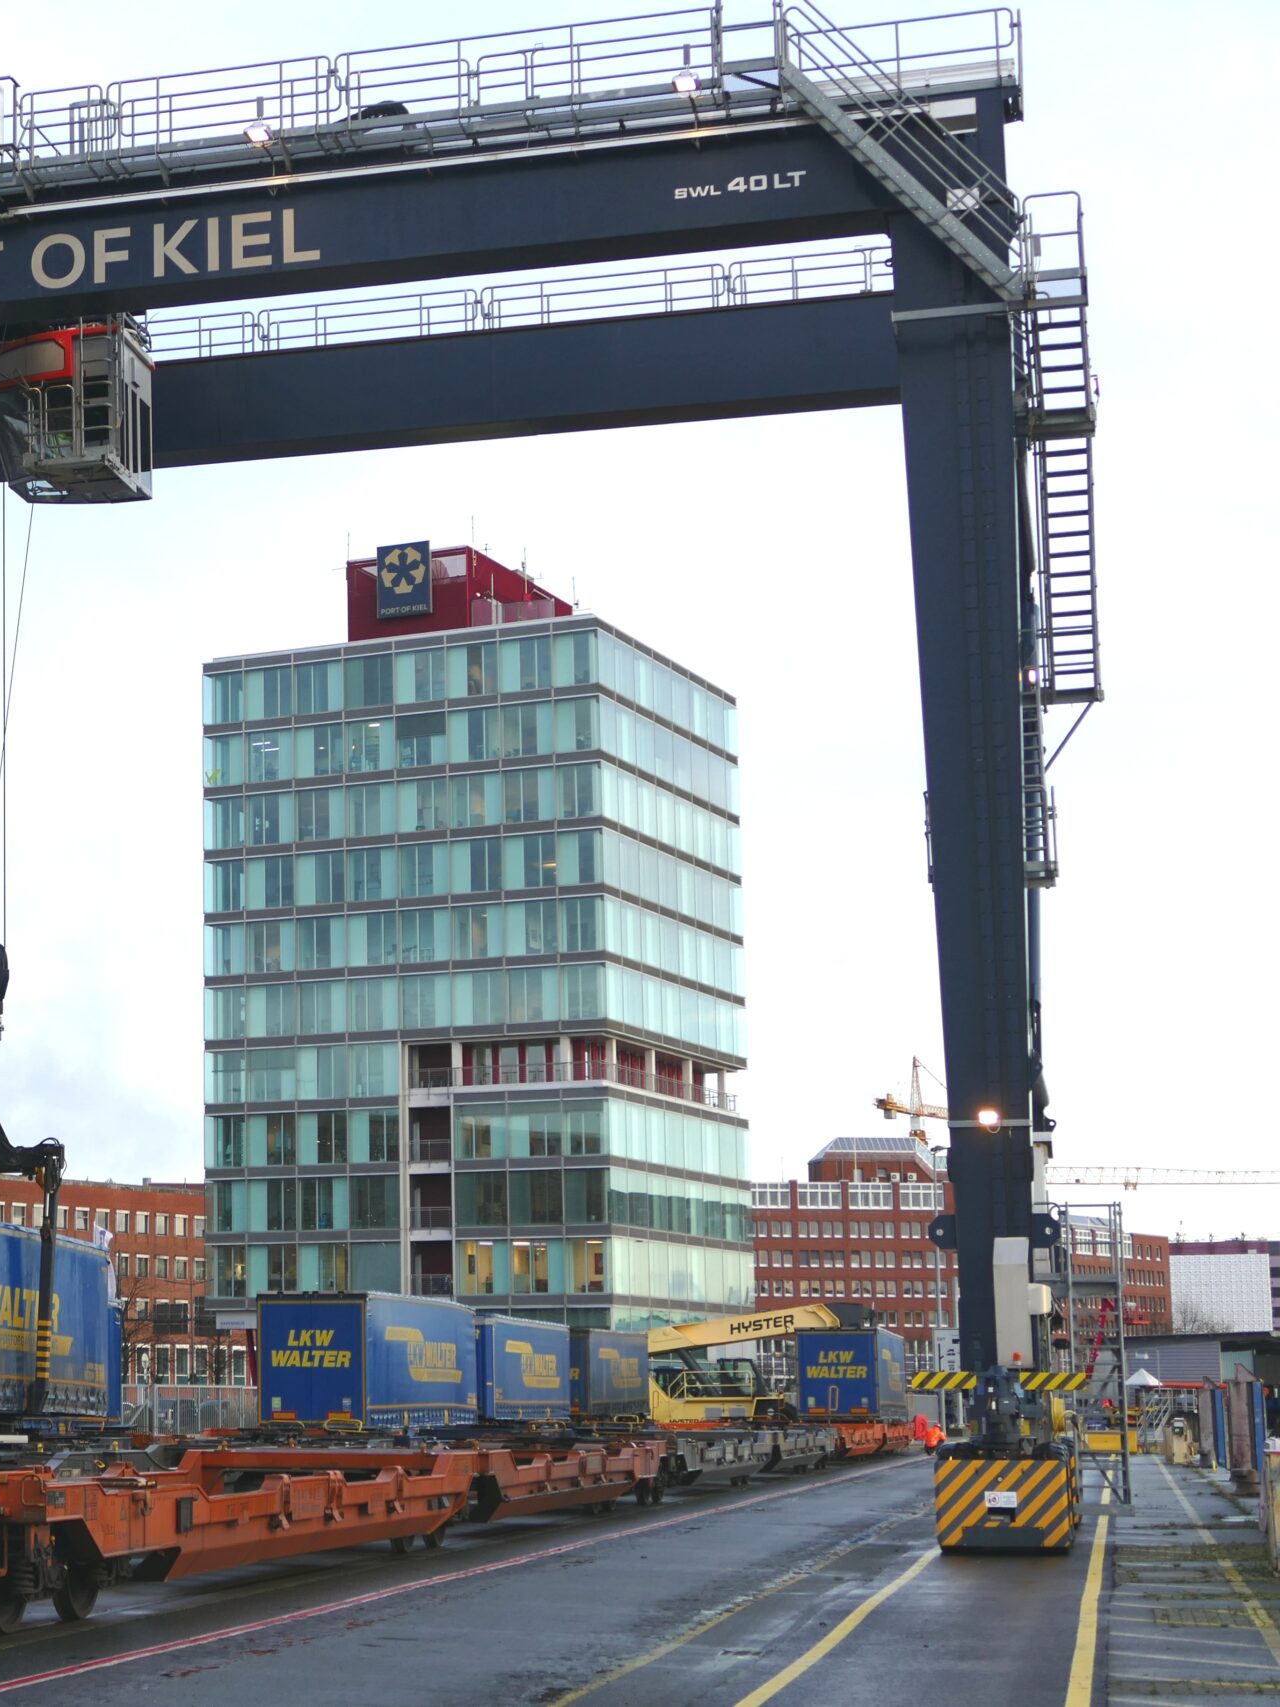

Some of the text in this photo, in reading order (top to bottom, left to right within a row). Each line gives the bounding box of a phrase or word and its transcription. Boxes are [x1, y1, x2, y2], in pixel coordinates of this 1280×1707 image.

[674, 170, 807, 199] SWL 40 LT
[30, 227, 131, 289] OF
[153, 208, 320, 278] KIEL
[381, 607, 400, 615] PORT
[401, 605, 412, 613] OF
[730, 1314, 794, 1335] HYSTER
[287, 1329, 335, 1347] LKW
[271, 1350, 352, 1368] WALTER
[818, 1350, 854, 1364] LKW
[806, 1365, 868, 1379] WALTER
